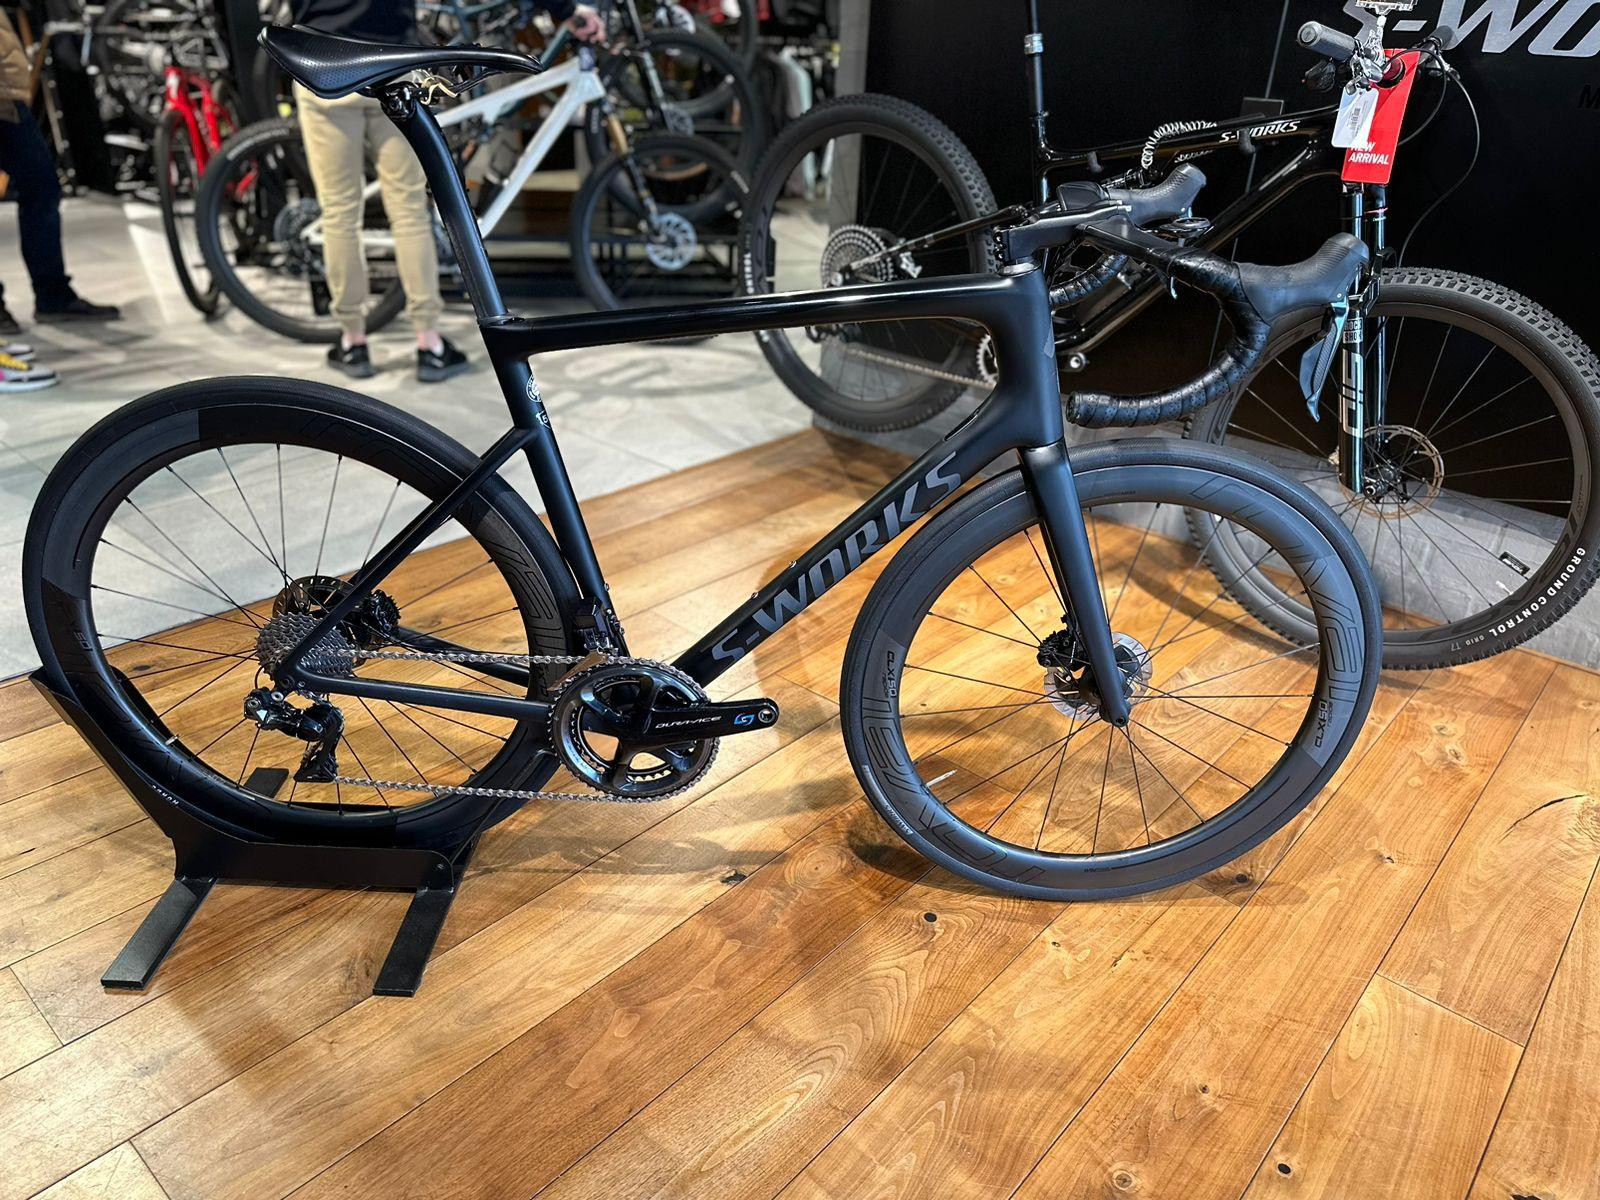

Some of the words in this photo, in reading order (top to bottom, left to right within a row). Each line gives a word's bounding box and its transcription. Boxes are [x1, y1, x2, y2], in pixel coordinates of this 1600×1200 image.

[1348, 152, 1390, 165] ARRIVAL
[711, 451, 961, 664] S-WORKS
[1546, 547, 1587, 597] GROUND
[1488, 596, 1548, 637] CONTROL
